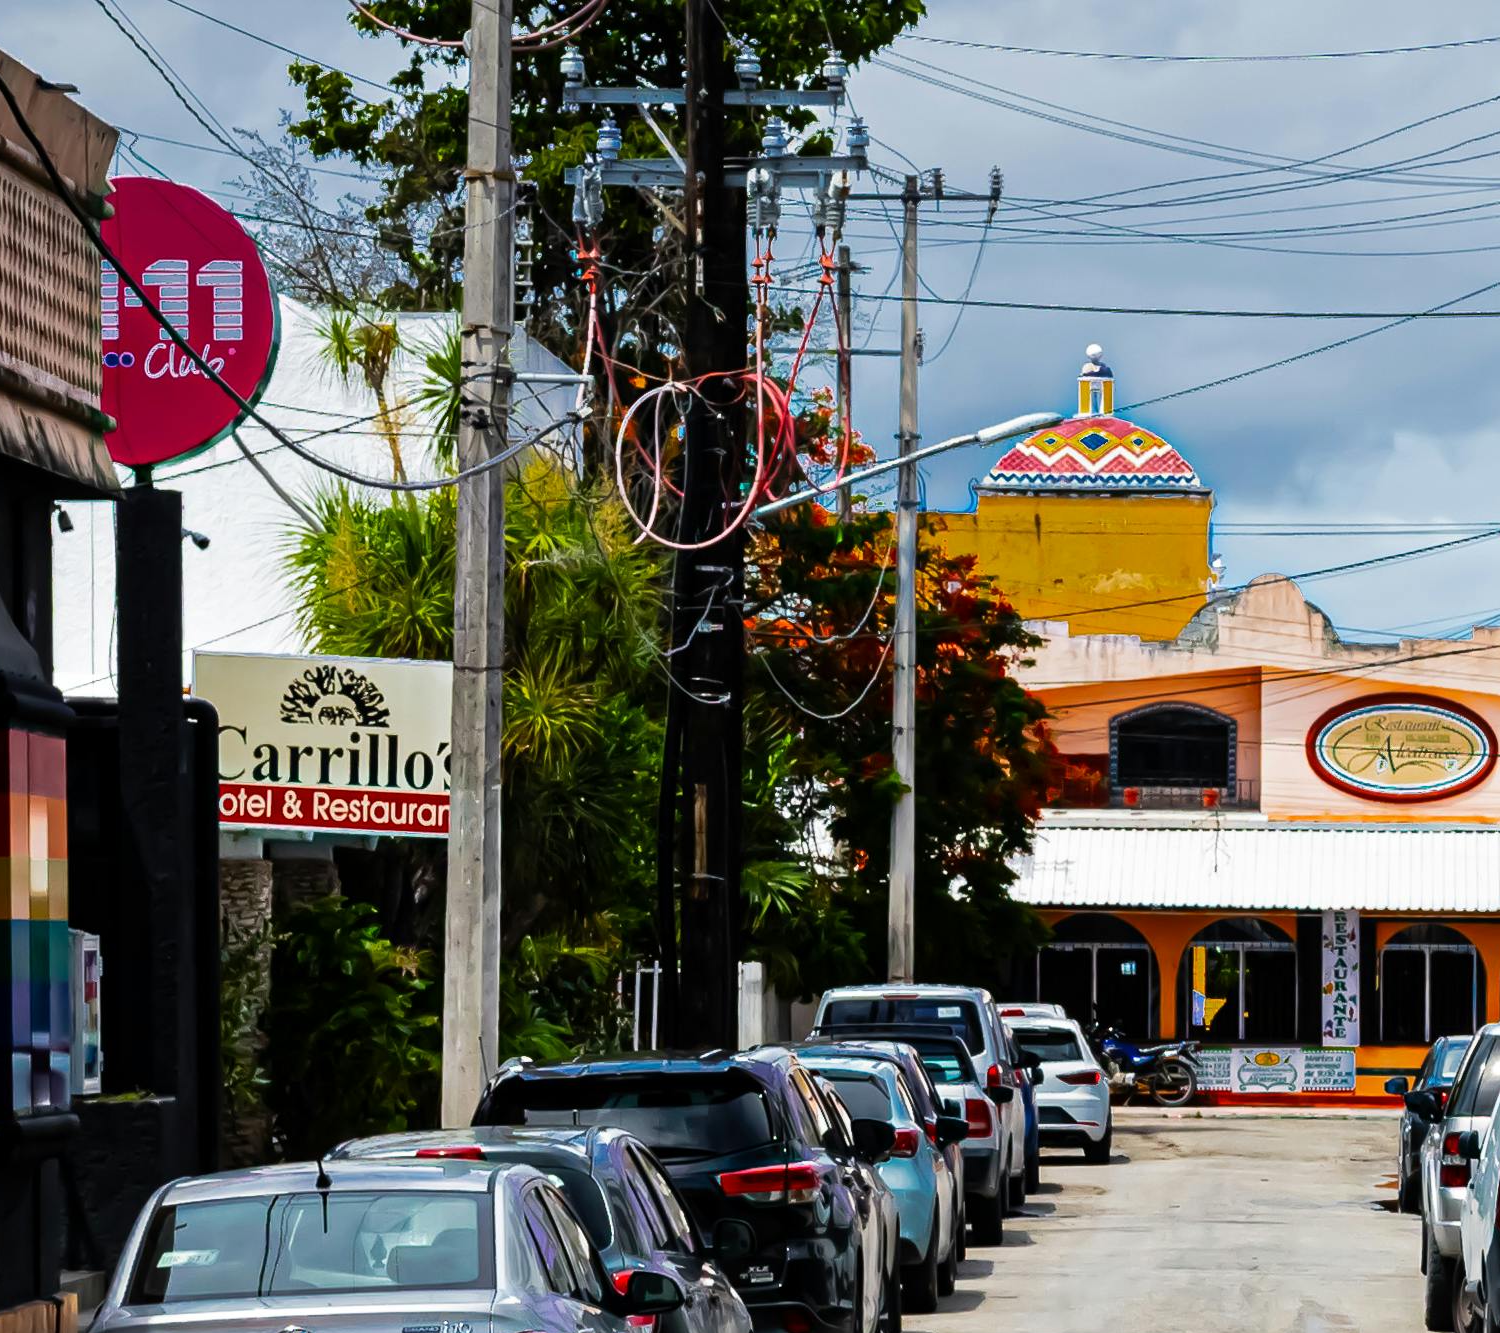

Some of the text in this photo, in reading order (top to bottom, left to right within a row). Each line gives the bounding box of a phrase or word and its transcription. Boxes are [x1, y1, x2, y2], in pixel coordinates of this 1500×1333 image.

[144, 343, 225, 380] Club
[218, 787, 451, 827] otel & Restauran
[1333, 911, 1347, 1039] RESTAURANTE
